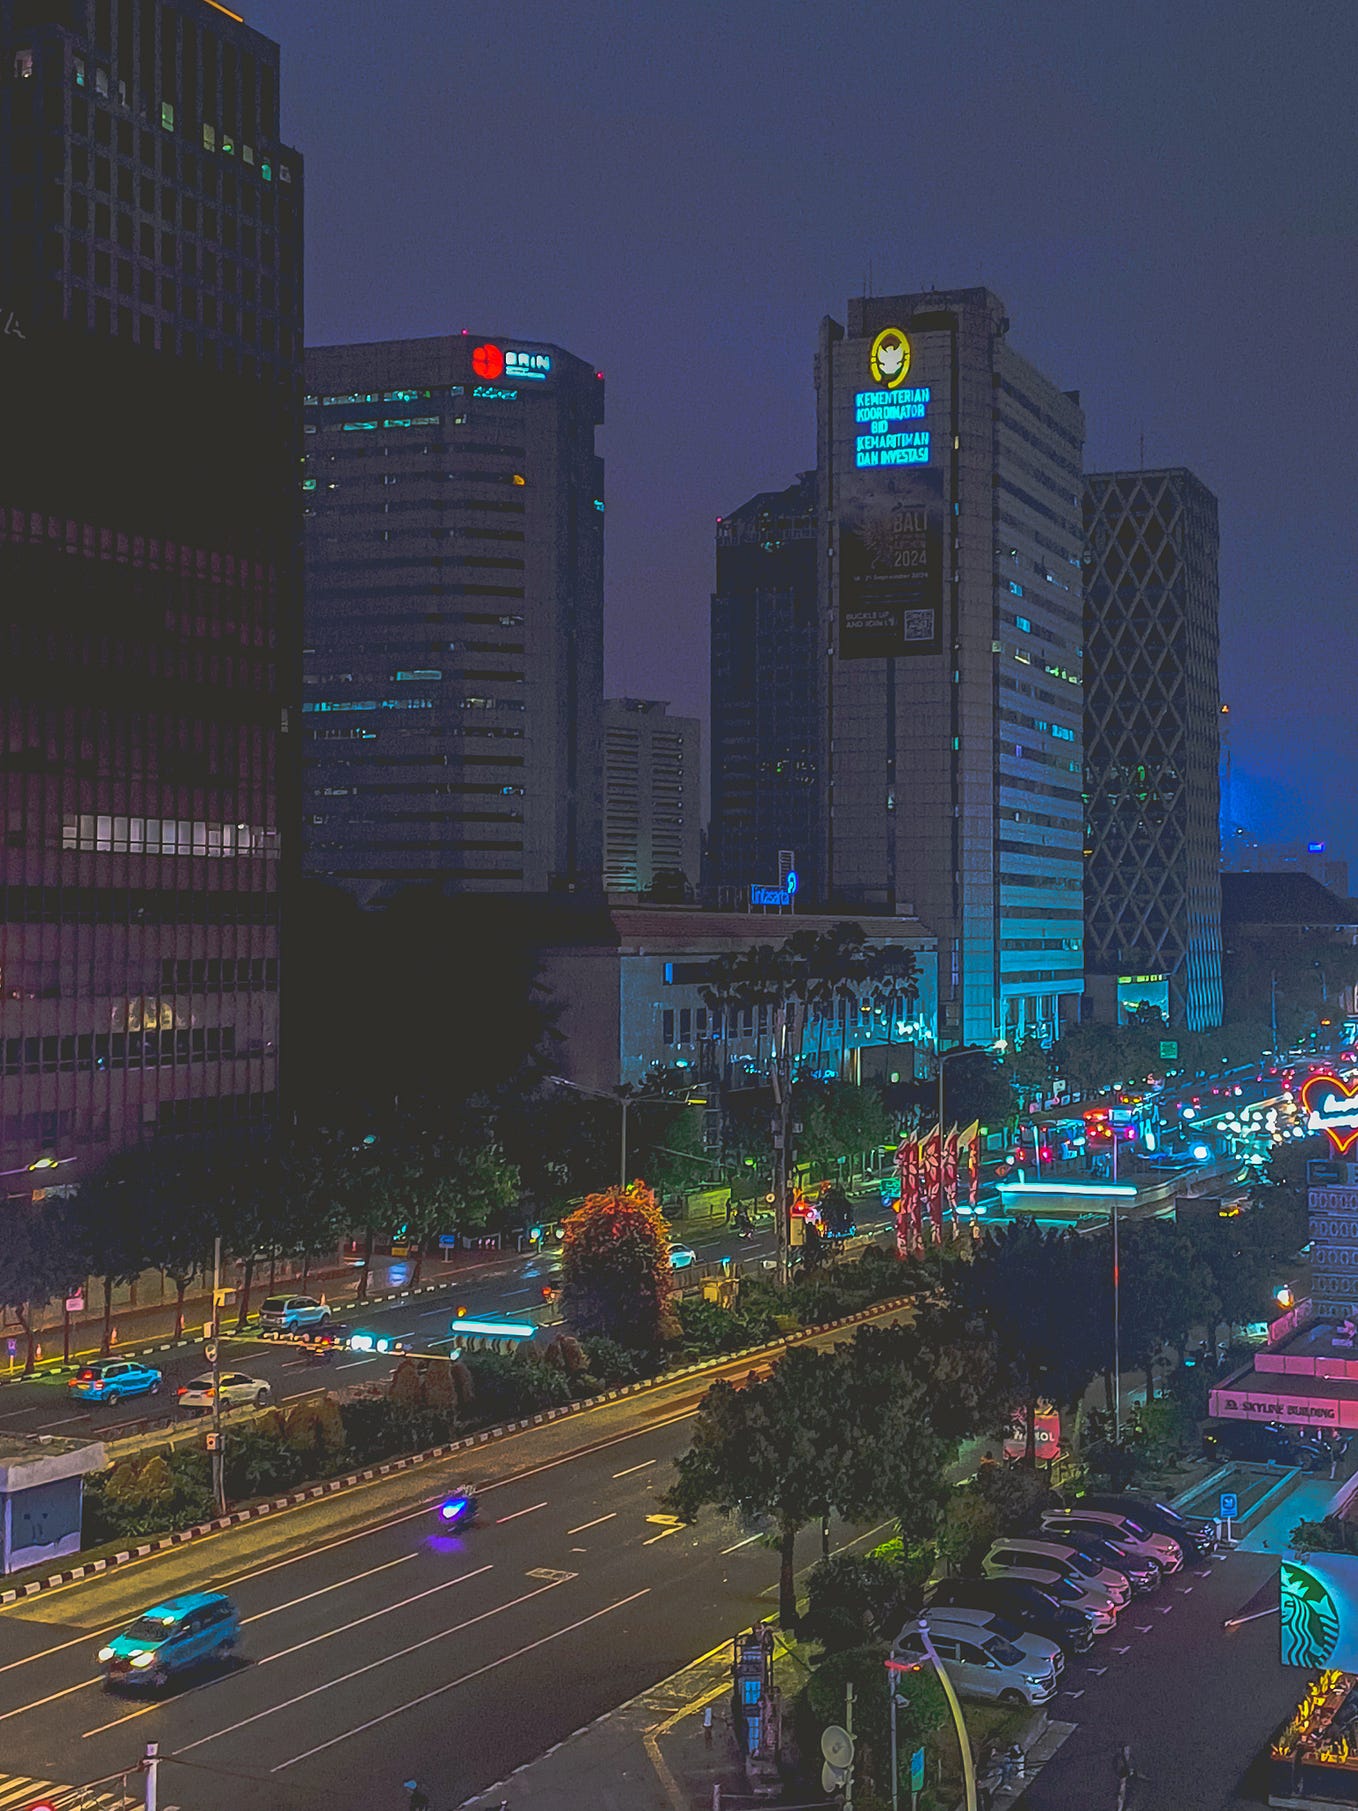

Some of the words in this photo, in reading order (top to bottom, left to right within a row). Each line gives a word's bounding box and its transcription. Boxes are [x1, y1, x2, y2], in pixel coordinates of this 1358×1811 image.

[856, 388, 930, 407] KEMENTERIAN
[856, 404, 925, 422] KOORDINATOR
[871, 420, 889, 434] BID
[856, 432, 930, 451] KEMARITIMAN
[856, 451, 879, 467] DAN
[880, 447, 929, 465] INVESTASI
[894, 511, 928, 533] BALI
[894, 550, 928, 567] 2024
[1242, 1401, 1284, 1415] SKYLINE
[1287, 1405, 1335, 1419] BUILDING
